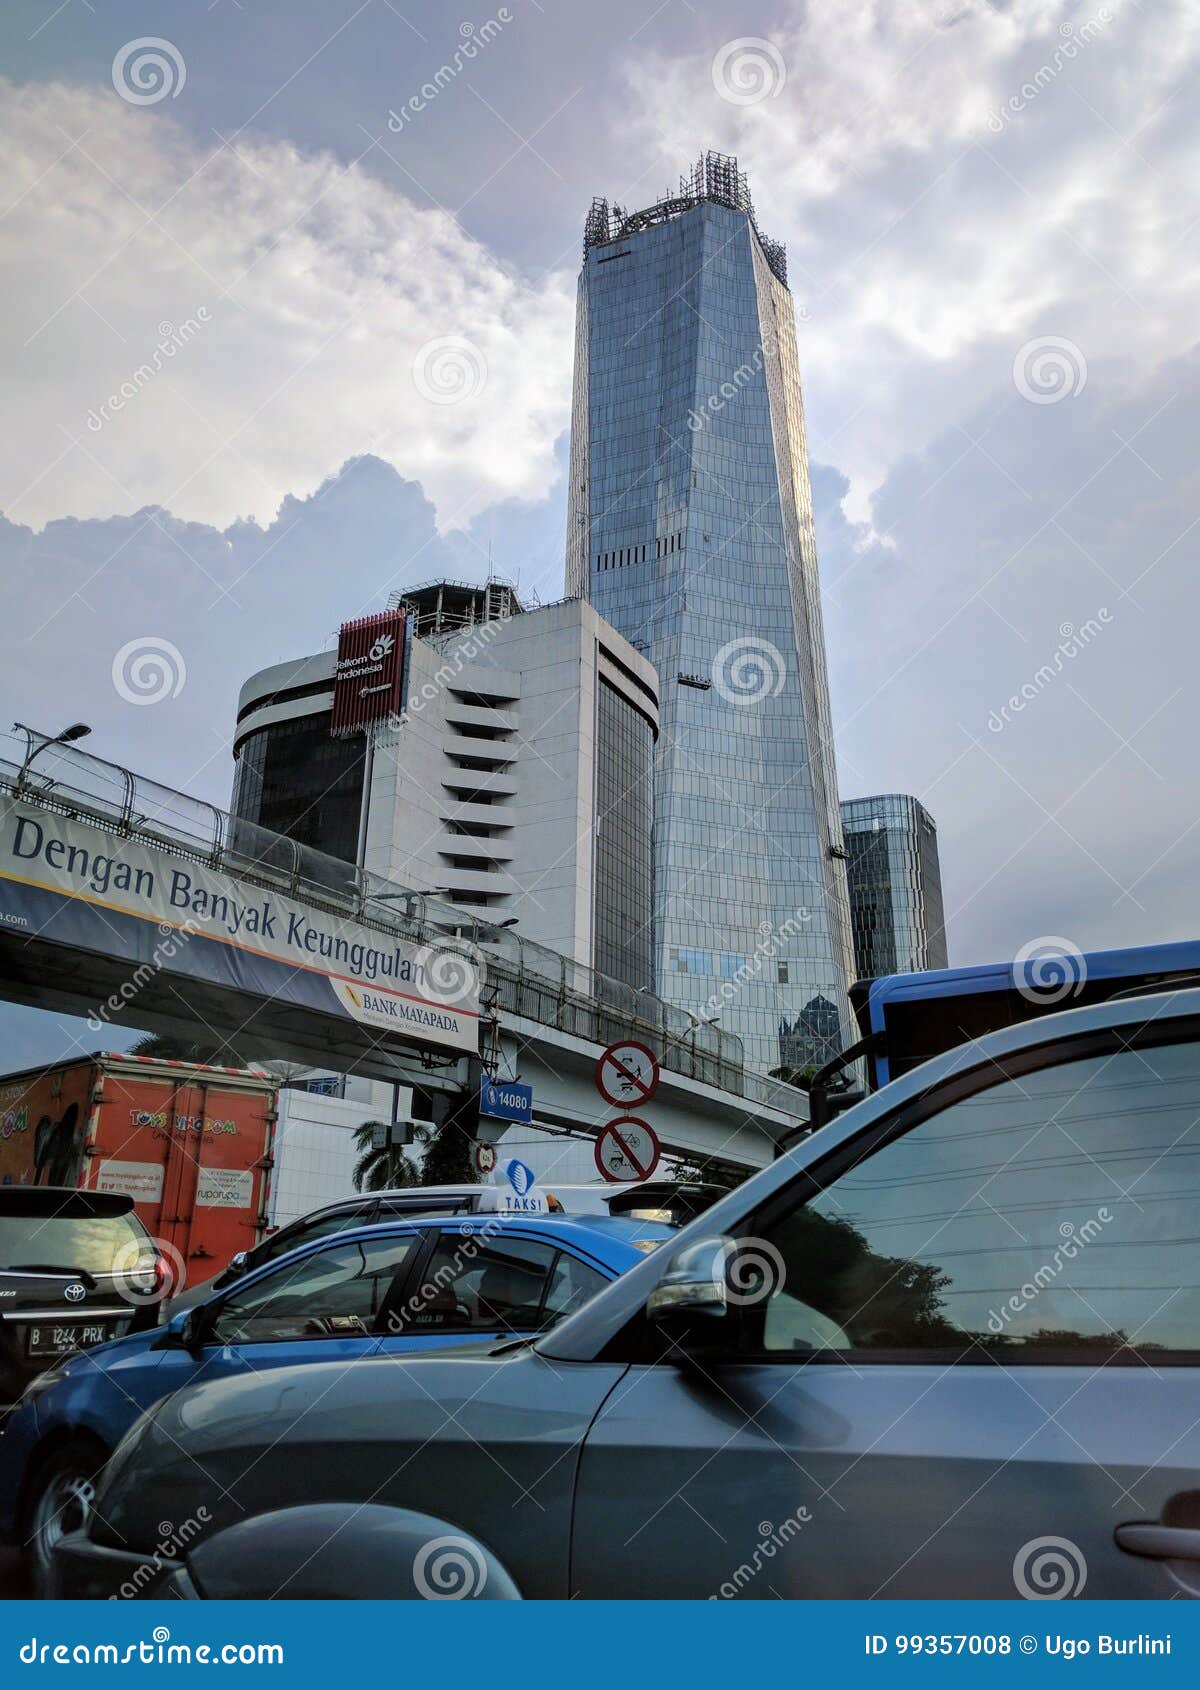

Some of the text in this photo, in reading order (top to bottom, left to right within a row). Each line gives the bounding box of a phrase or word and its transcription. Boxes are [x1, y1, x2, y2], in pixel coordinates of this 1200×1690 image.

[338, 664, 383, 681] Indonesia
[12, 815, 426, 986] Dengan Banyak Keunggulan
[362, 993, 398, 1016] BANK
[399, 1006, 460, 1034] MAYAPADA
[498, 1091, 528, 1111] 14080
[505, 1196, 541, 1211] TAKSI
[32, 1328, 40, 1345] B
[83, 1327, 104, 1343] PRX
